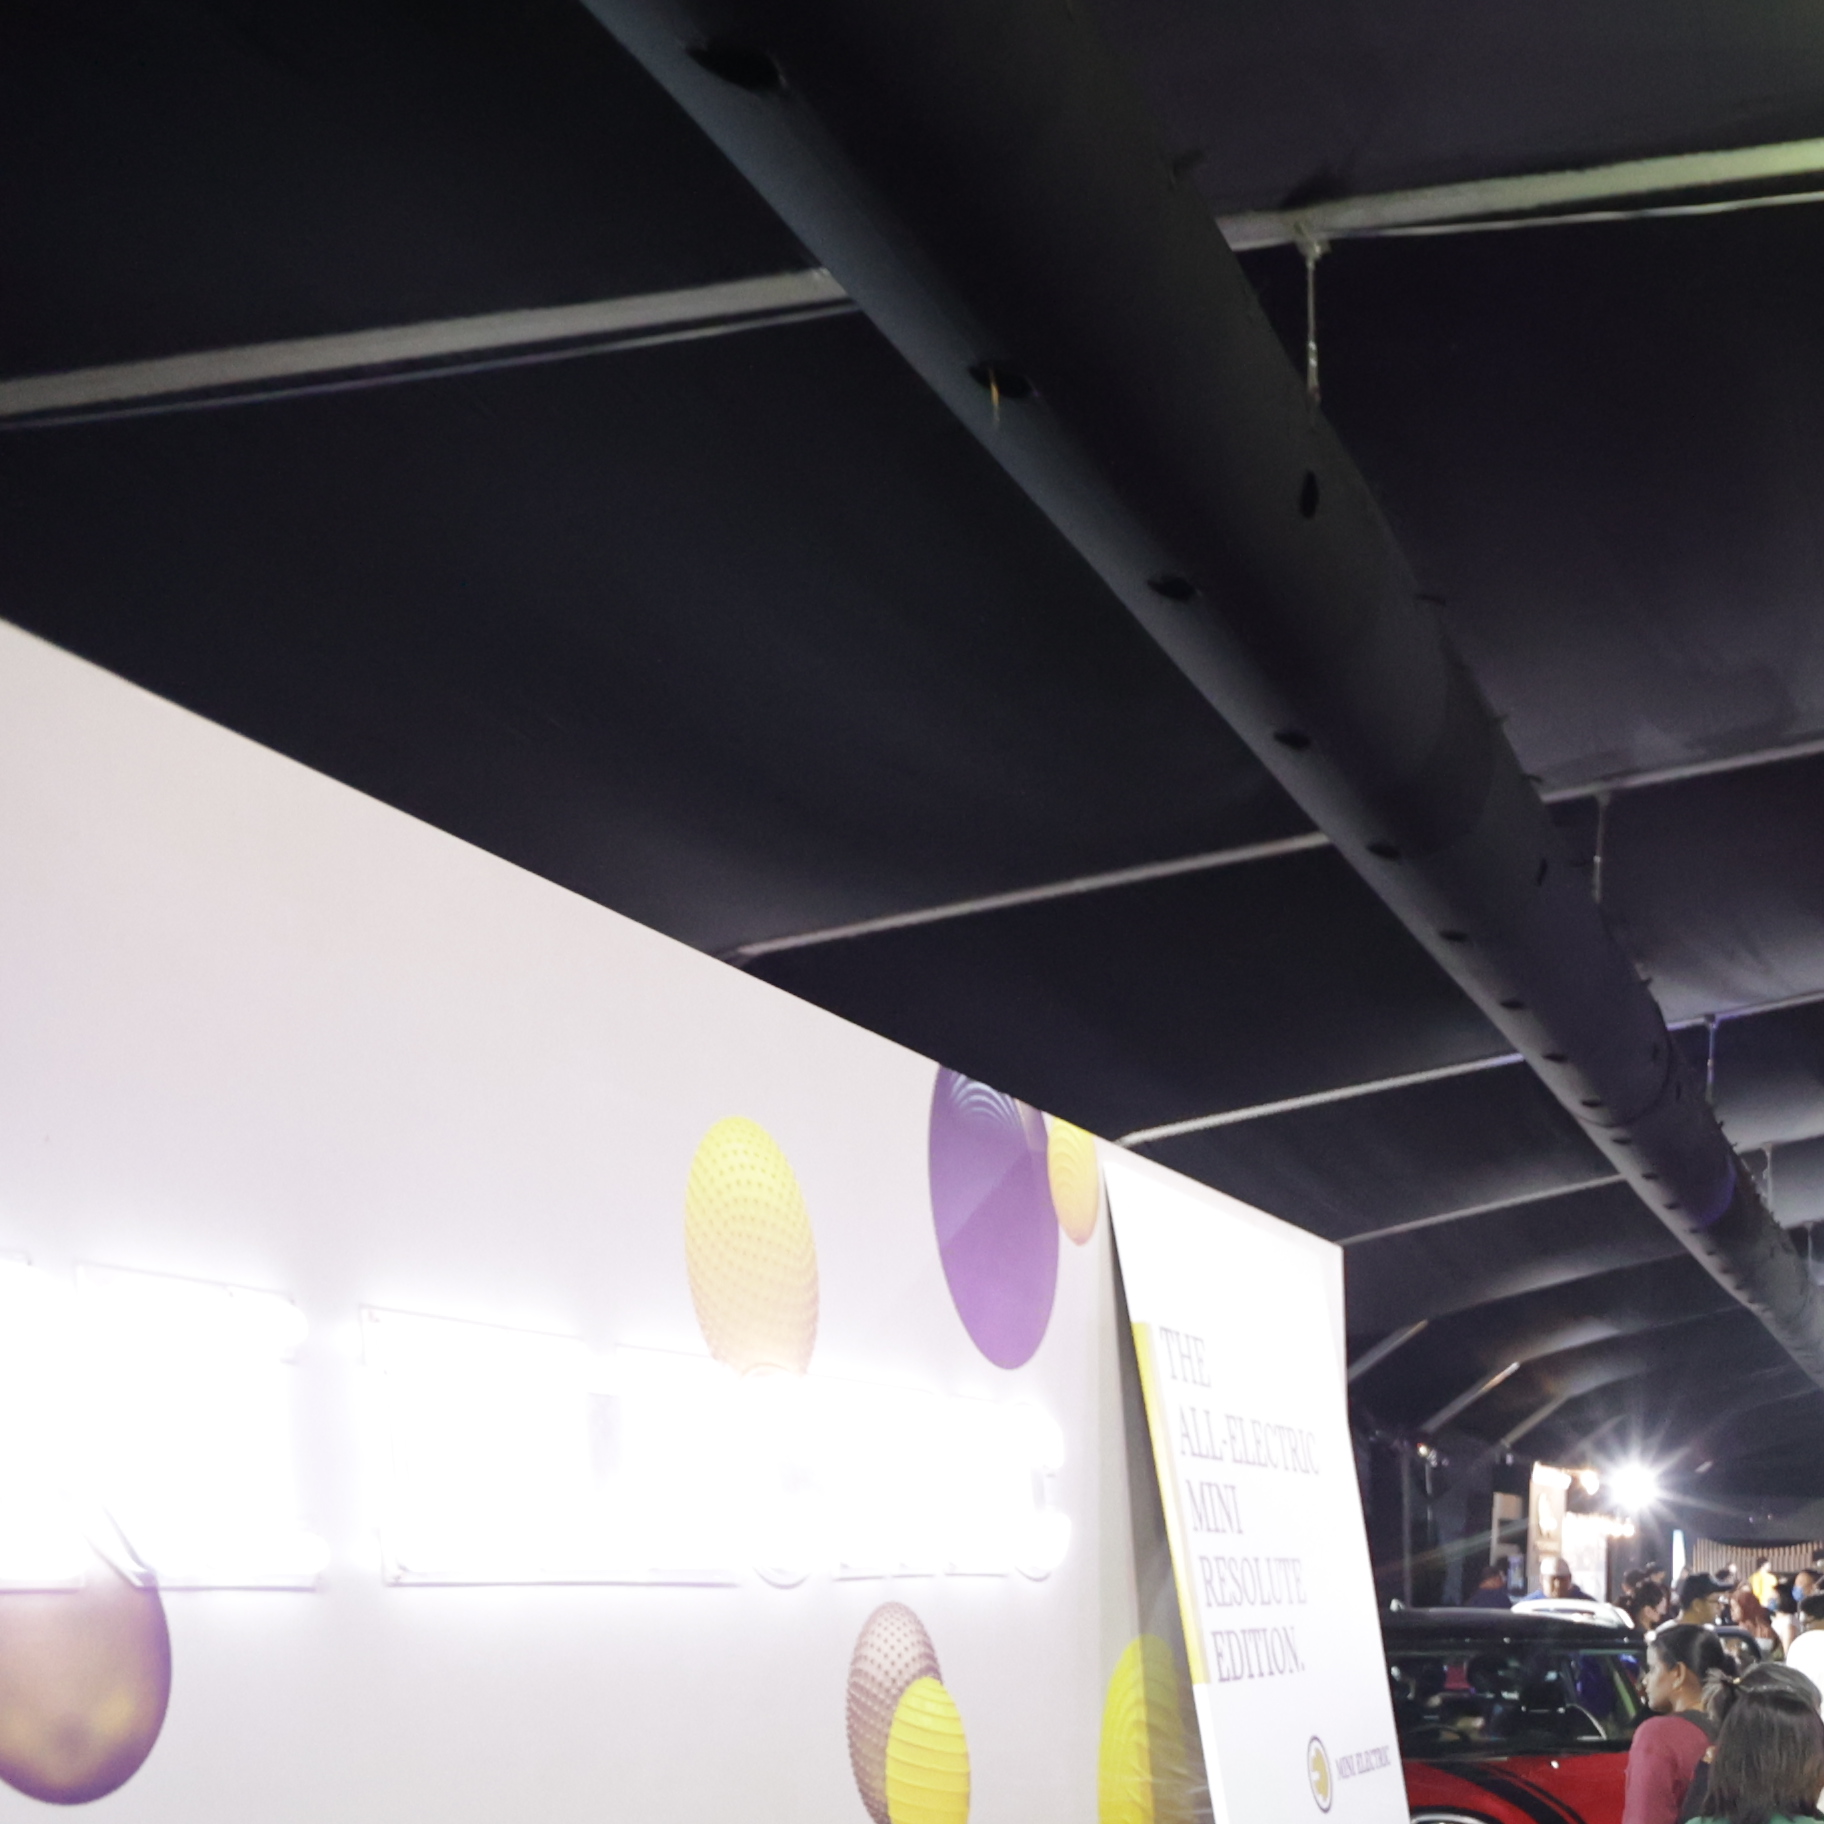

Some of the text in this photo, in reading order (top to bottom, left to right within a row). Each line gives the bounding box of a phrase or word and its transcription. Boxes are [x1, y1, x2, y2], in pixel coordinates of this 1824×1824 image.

[1158, 1326, 1211, 1388] THE
[1179, 1404, 1320, 1475] ALL-ELECTRIC
[1185, 1479, 1244, 1535] MINI
[1198, 1555, 1308, 1608] RESOLUTE
[1211, 1626, 1305, 1683] EDITION.
[1335, 1744, 1391, 1781] MINI ELECTRIC
